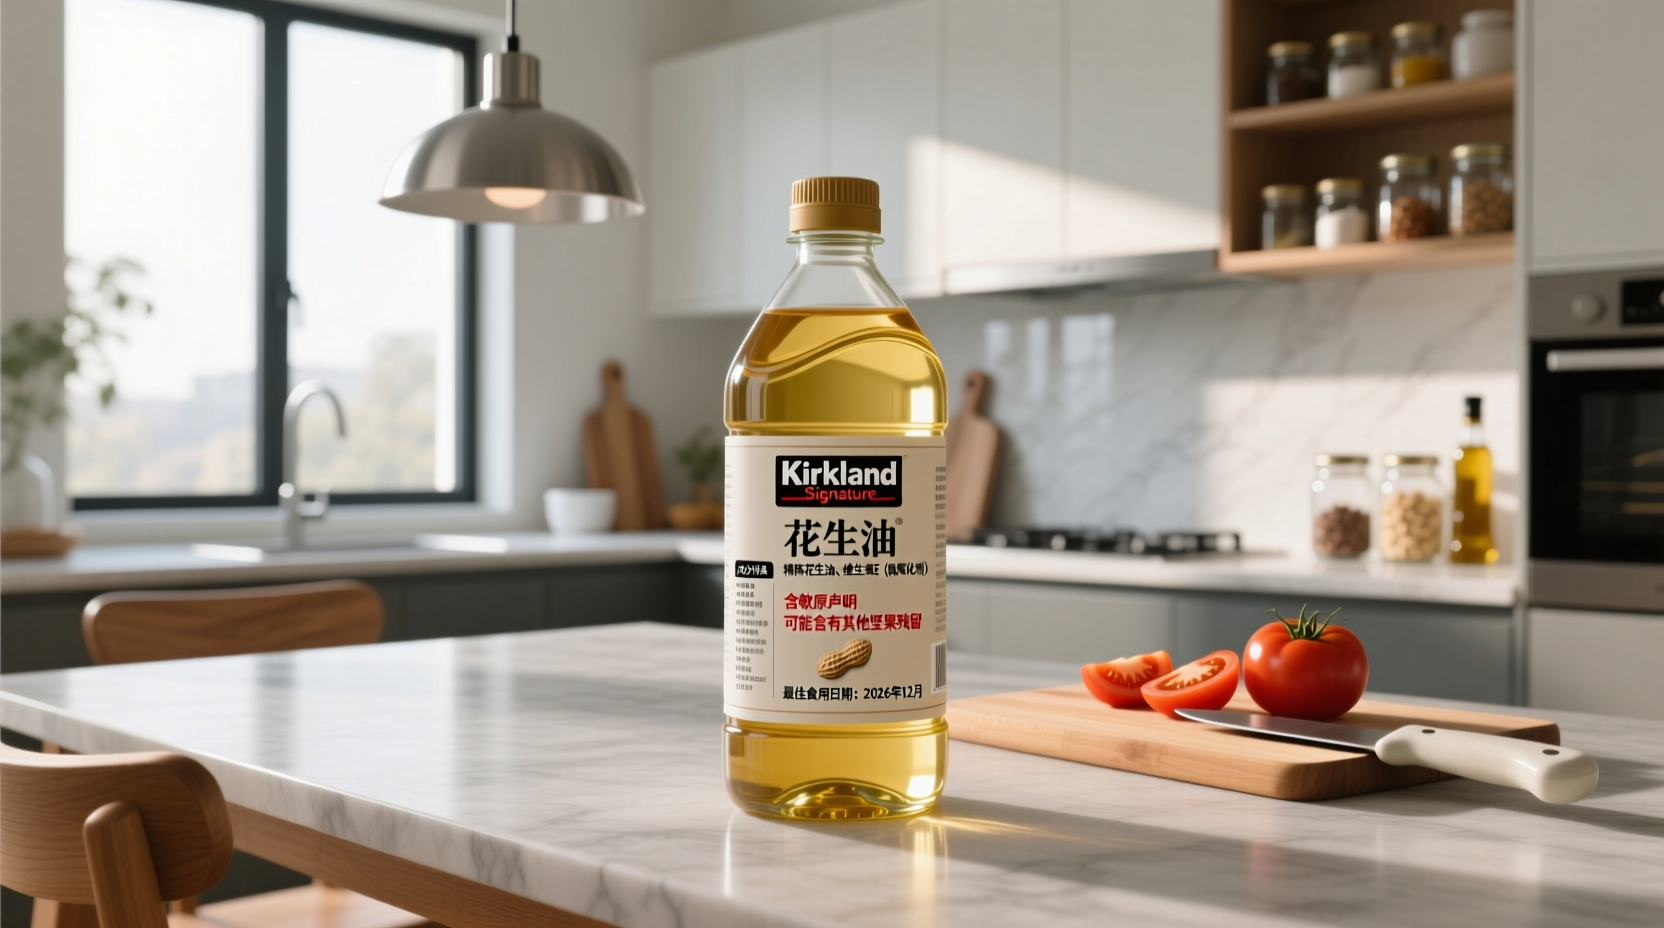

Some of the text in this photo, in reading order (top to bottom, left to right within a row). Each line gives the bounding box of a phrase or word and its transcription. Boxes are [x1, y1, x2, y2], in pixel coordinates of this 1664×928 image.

[782, 460, 897, 486] Kirkland
[804, 486, 877, 505] Signature
[784, 518, 896, 558] 花生油
